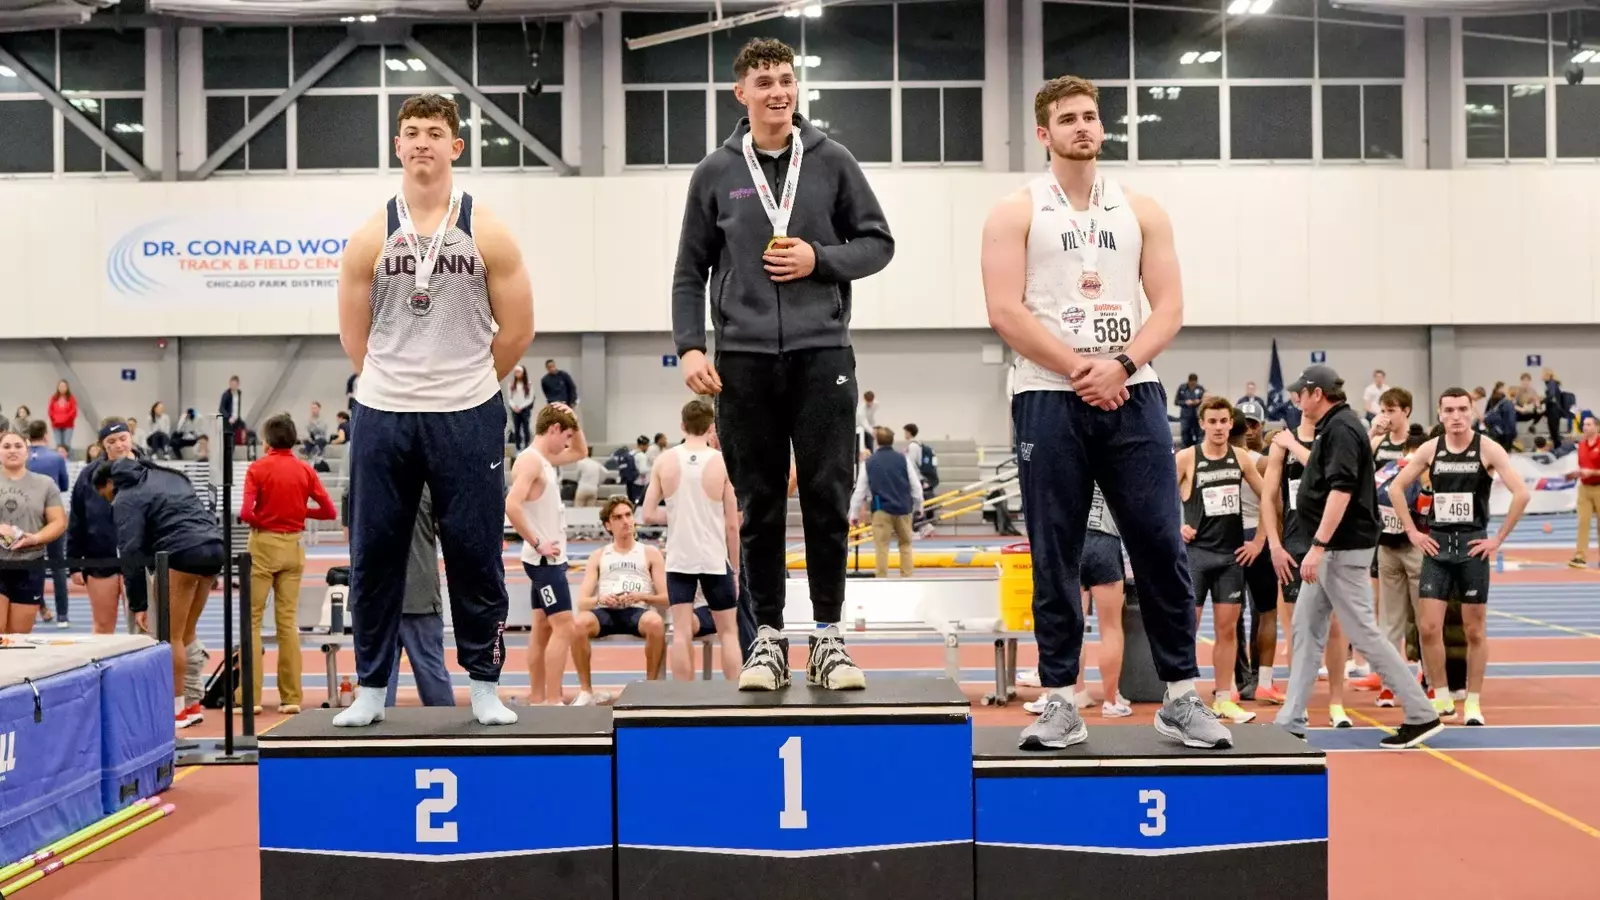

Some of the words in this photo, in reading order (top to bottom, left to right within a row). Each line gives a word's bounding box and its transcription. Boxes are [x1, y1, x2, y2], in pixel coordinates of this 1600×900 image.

[143, 241, 181, 256] DR.
[187, 239, 292, 256] CONRAD
[178, 258, 233, 271] TRACK
[238, 258, 249, 270] &
[254, 258, 300, 270] FIELD
[206, 279, 256, 289] CHICAGO
[259, 279, 288, 288] PARK
[291, 279, 339, 288] DISTRIC
[1093, 317, 1131, 343] 589
[1221, 494, 1239, 508] 487
[1449, 502, 1470, 516] 469
[622, 580, 642, 592] 609
[543, 588, 553, 604] 8
[779, 736, 808, 829] 1
[415, 768, 458, 842] 2
[1138, 789, 1166, 837] 3
